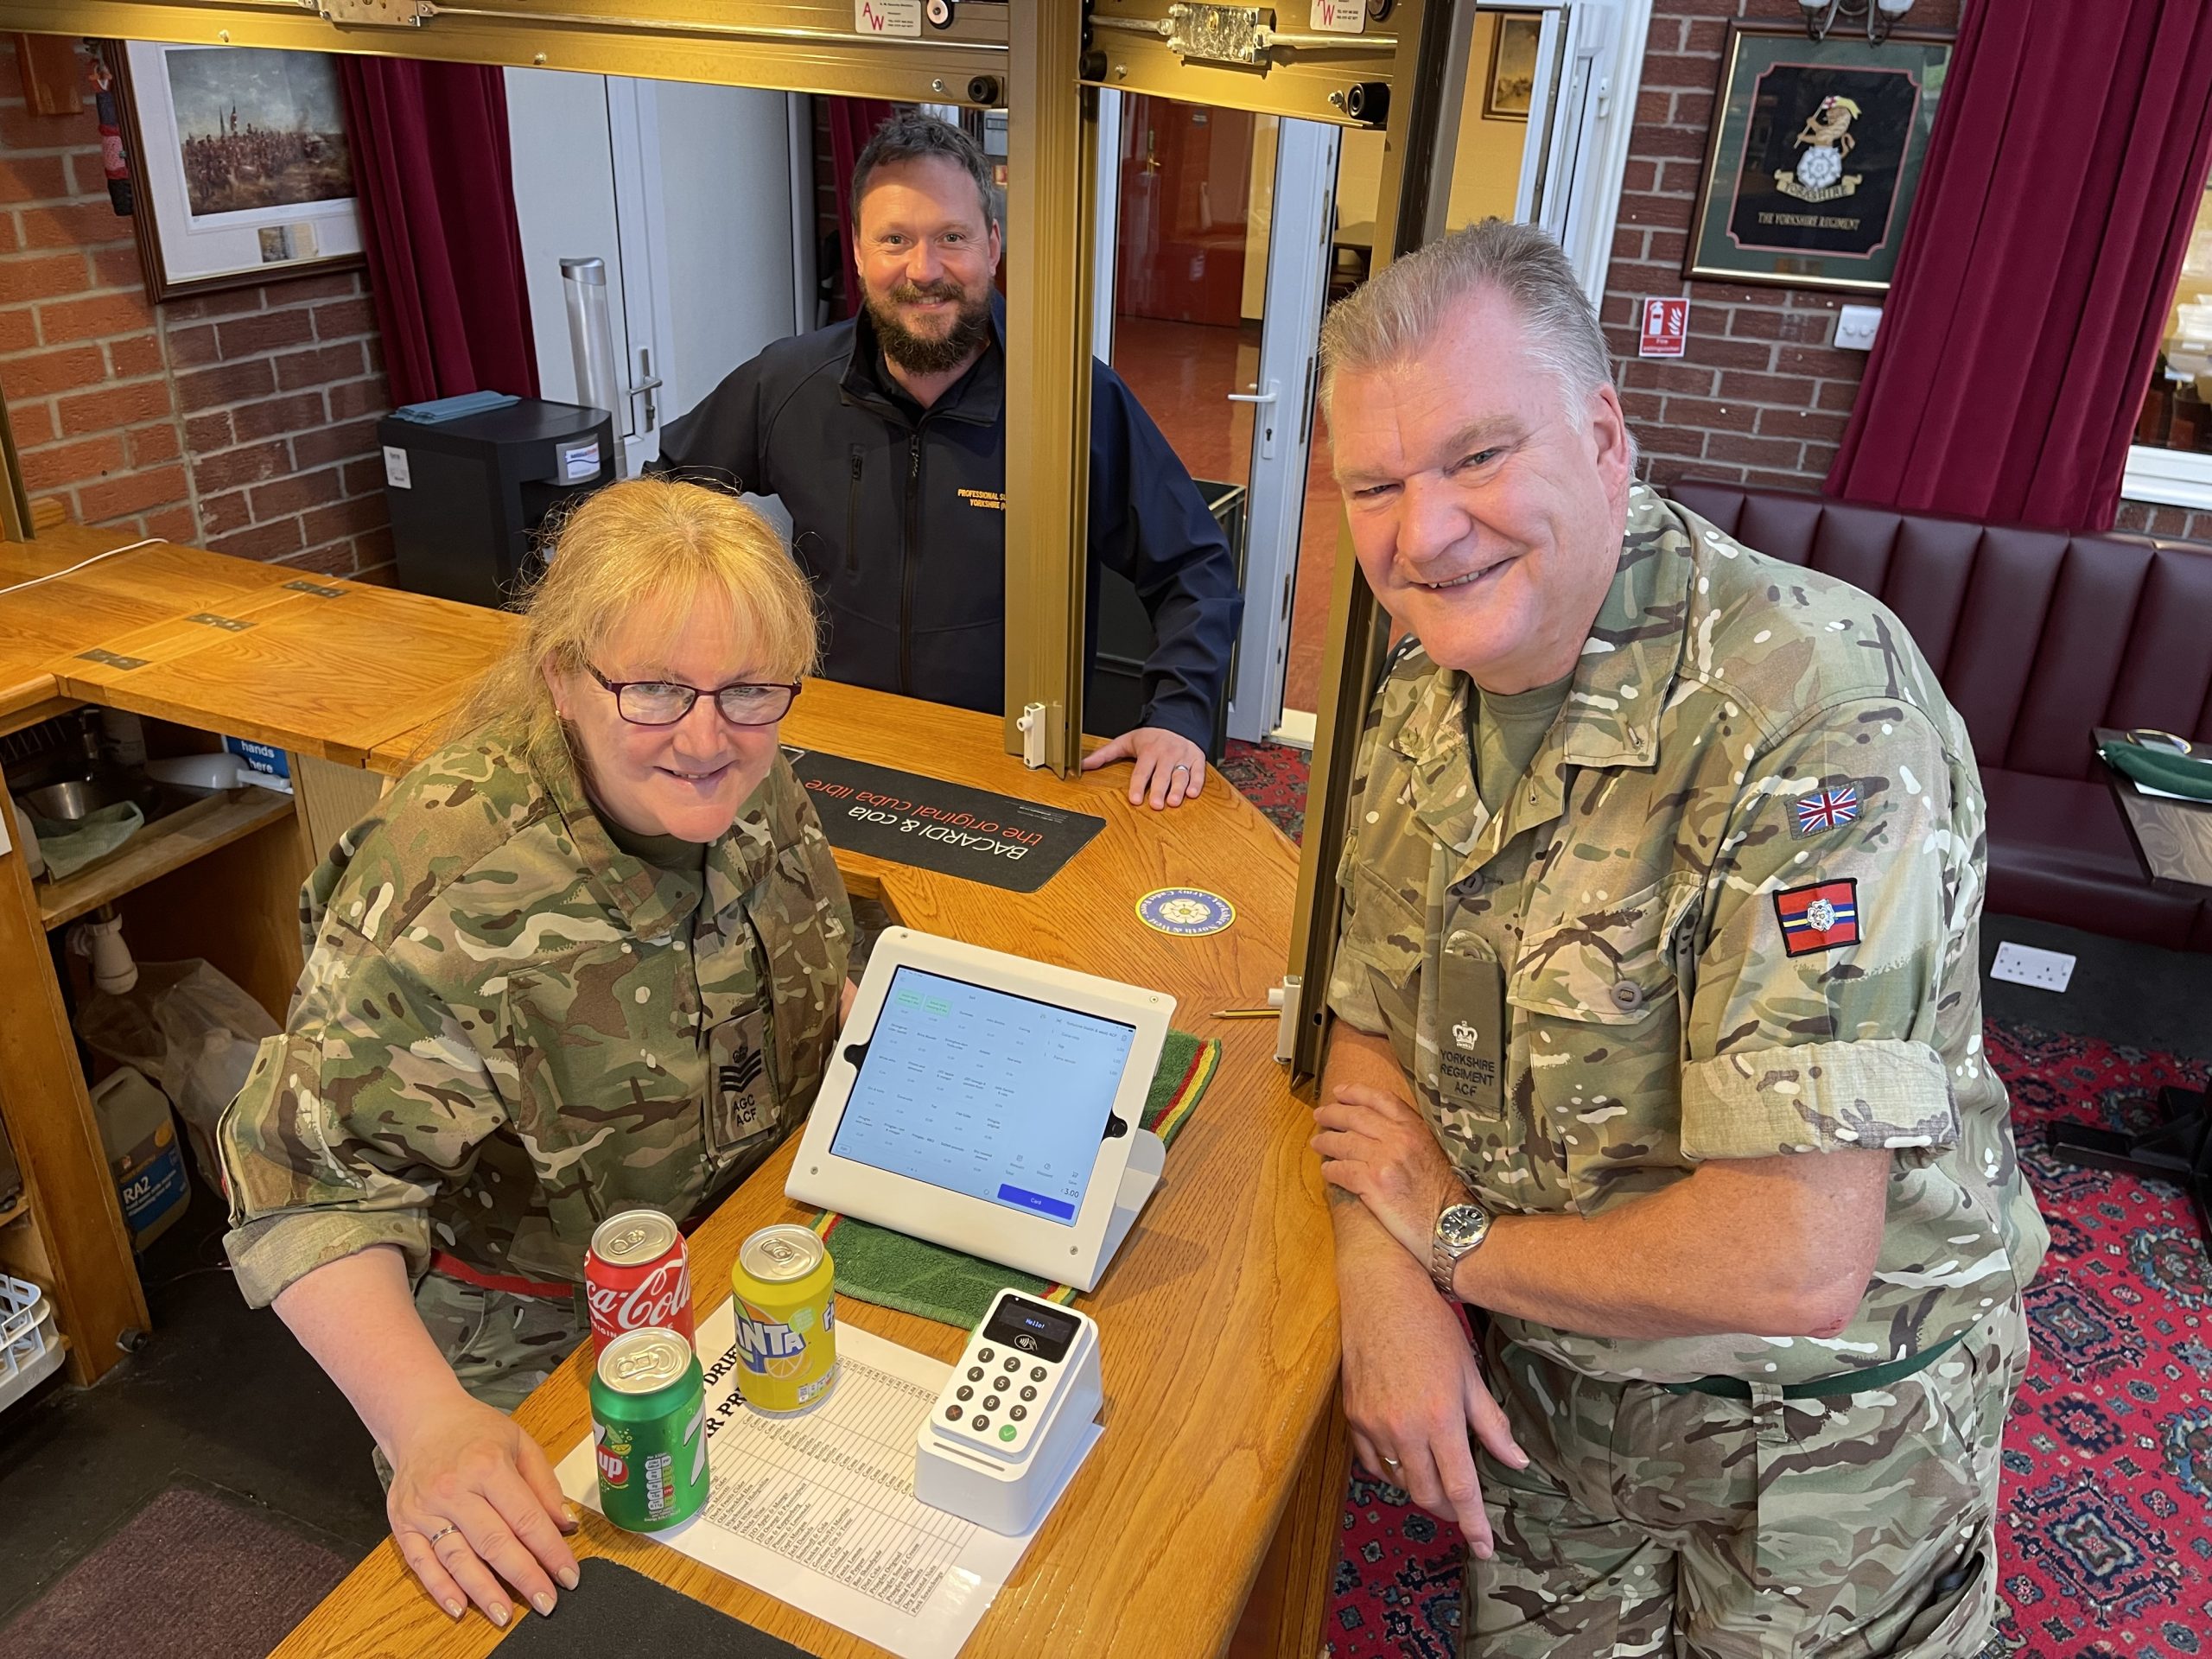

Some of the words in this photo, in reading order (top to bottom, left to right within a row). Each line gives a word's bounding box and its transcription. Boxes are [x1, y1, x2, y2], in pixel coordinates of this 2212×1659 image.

[957, 488, 999, 500] PROFESSIONAL
[969, 499, 1001, 509] YORKSHIRE
[241, 740, 275, 759] hands
[249, 757, 274, 774] here
[804, 779, 853, 799] libre
[855, 791, 912, 810] cuba
[848, 805, 898, 825] cola
[912, 804, 999, 832] original
[900, 818, 920, 833] &
[918, 826, 1029, 861] BACARDI
[1002, 825, 1044, 847] the
[1440, 1049, 1495, 1073] YORKSHIRE
[1440, 1064, 1494, 1087] REGIMENT
[1454, 1081, 1478, 1097] ACF
[733, 1094, 755, 1115] AGC
[736, 1108, 757, 1127] ACF
[1028, 1196, 1042, 1205] Card
[1063, 1186, 1080, 1198] 3.00
[1025, 1318, 1046, 1329] Hello!
[982, 1351, 988, 1360] 1
[1007, 1360, 1016, 1369] 2
[1034, 1370, 1042, 1379] 3
[971, 1370, 979, 1378] 4
[997, 1379, 1005, 1388] 5
[1024, 1389, 1032, 1398] 6
[962, 1389, 969, 1397] 7
[988, 1398, 995, 1408] 8
[1014, 1408, 1022, 1417] 9
[742, 1414, 753, 1424] Cans
[749, 1417, 760, 1427] Cans
[757, 1420, 768, 1431] Cans
[764, 1423, 775, 1433] Cans
[976, 1418, 984, 1427] 0
[779, 1429, 790, 1440] Cans
[831, 1452, 842, 1464] Cans
[838, 1455, 850, 1466] Cans
[846, 1459, 858, 1470] Cans
[854, 1462, 865, 1473] Cans
[861, 1465, 873, 1477] Cans
[869, 1469, 880, 1480] Cans
[877, 1472, 888, 1484] Cans
[885, 1475, 896, 1487] Cans
[893, 1478, 904, 1491] Cans
[900, 1483, 912, 1494] Cans
[709, 1507, 721, 1520] Dark
[720, 1493, 734, 1507] Fruits
[732, 1480, 745, 1493] Cider
[716, 1512, 727, 1522] Old
[725, 1492, 745, 1513] Speckled
[742, 1484, 753, 1494] Hen
[732, 1520, 742, 1530] Red
[740, 1508, 753, 1520] Wine
[740, 1519, 754, 1534] White
[752, 1506, 765, 1518] Wine
[757, 1513, 770, 1529] Apple
[772, 1492, 788, 1509] Mango
[762, 1515, 779, 1533] Orange
[771, 1531, 787, 1548] Pimms
[789, 1503, 810, 1526] Lemonade
[789, 1521, 807, 1540] Morgan
[828, 1536, 838, 1546] Gin
[839, 1517, 853, 1531] Tonic
[764, 1535, 773, 1545] Gin
[787, 1544, 798, 1557] Jack
[796, 1526, 813, 1545] Daniels
[795, 1537, 816, 1560] Smirnoff
[817, 1521, 828, 1533] Cola
[819, 1558, 832, 1571] Coca
[830, 1546, 842, 1558] Cola
[827, 1549, 849, 1575] Lemonade
[836, 1563, 849, 1579] Fanta
[847, 1547, 862, 1564] Lemon
[843, 1574, 852, 1583] Dr
[849, 1557, 865, 1575] Pepper
[860, 1578, 872, 1590] Diet
[869, 1565, 880, 1578] Coke
[868, 1573, 887, 1594] Pringles
[884, 1551, 902, 1573] Original
[877, 1577, 894, 1598] Pringles
[892, 1564, 903, 1577] Sour
[906, 1542, 919, 1559] Cream
[852, 1576, 861, 1586] Bar
[885, 1580, 903, 1601] Pringles
[900, 1567, 914, 1580] BBQ
[893, 1587, 908, 1605] Salted
[906, 1568, 923, 1588] Peanuts
[902, 1599, 915, 1609] Dry
[910, 1576, 927, 1599] Roasted
[925, 1565, 936, 1578] Nuts
[911, 1599, 923, 1613] Pork
[920, 1571, 943, 1600] Scratchings
